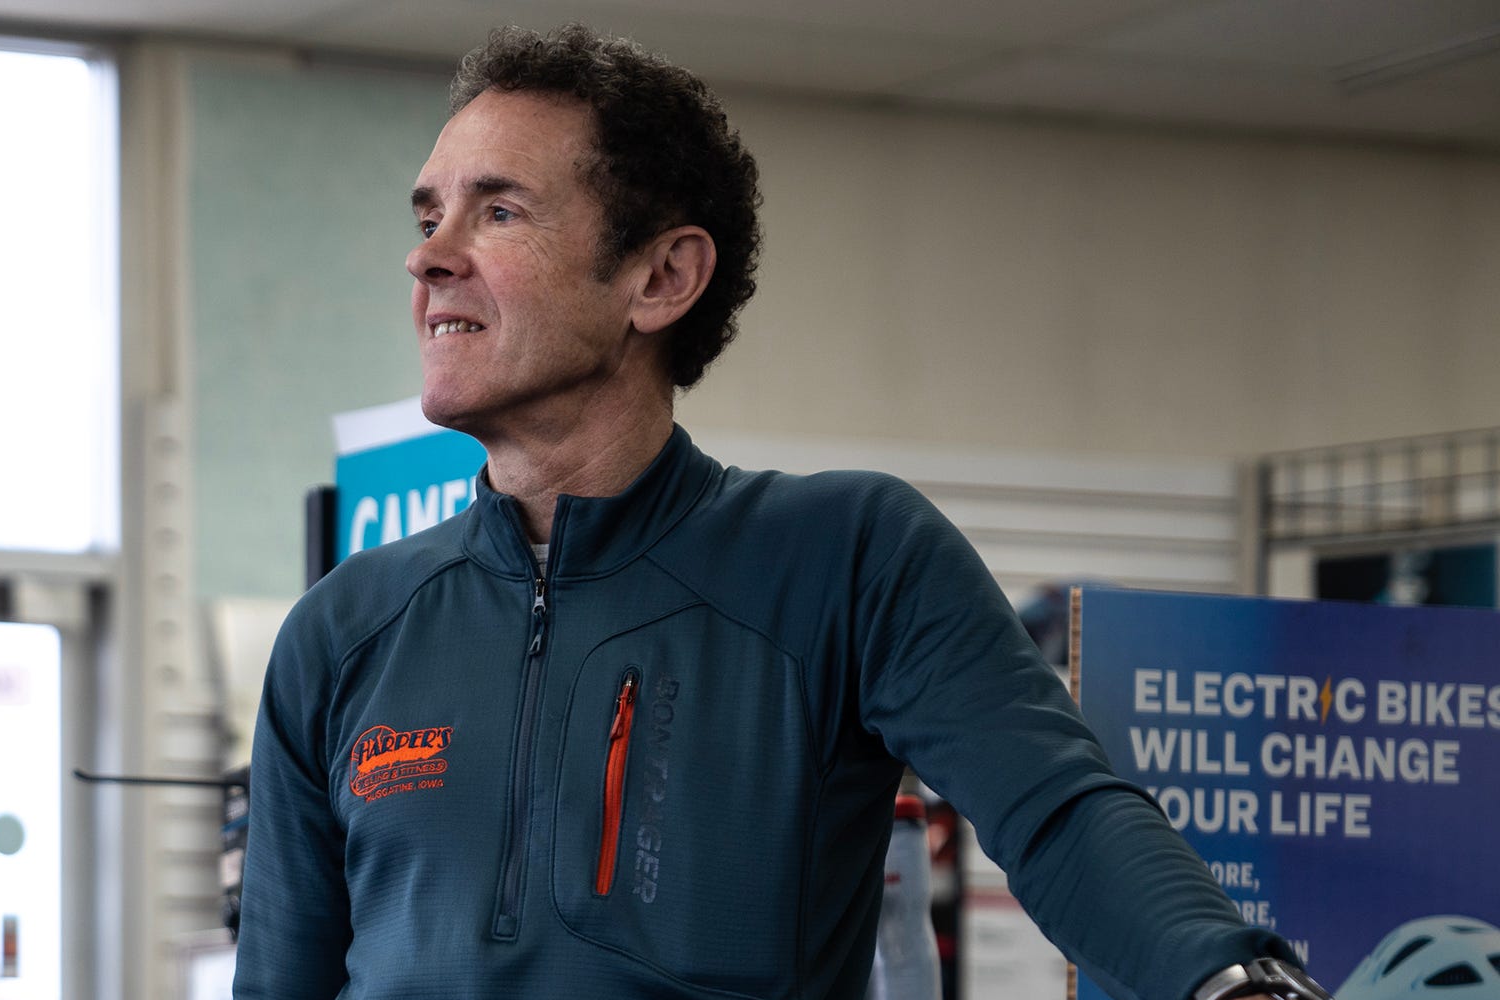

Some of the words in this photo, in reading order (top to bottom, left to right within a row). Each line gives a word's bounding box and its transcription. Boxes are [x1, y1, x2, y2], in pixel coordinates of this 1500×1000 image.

[349, 475, 477, 555] CAME
[1133, 668, 1367, 725] ELECTRIC
[357, 727, 452, 767] HARPER'S
[401, 761, 445, 776] FITNESS
[1129, 726, 1251, 776] WILL
[1260, 731, 1460, 784] CHANGE
[417, 779, 445, 790] IOWA
[1270, 790, 1372, 838] LIFE
[1204, 861, 1260, 892] ORE,
